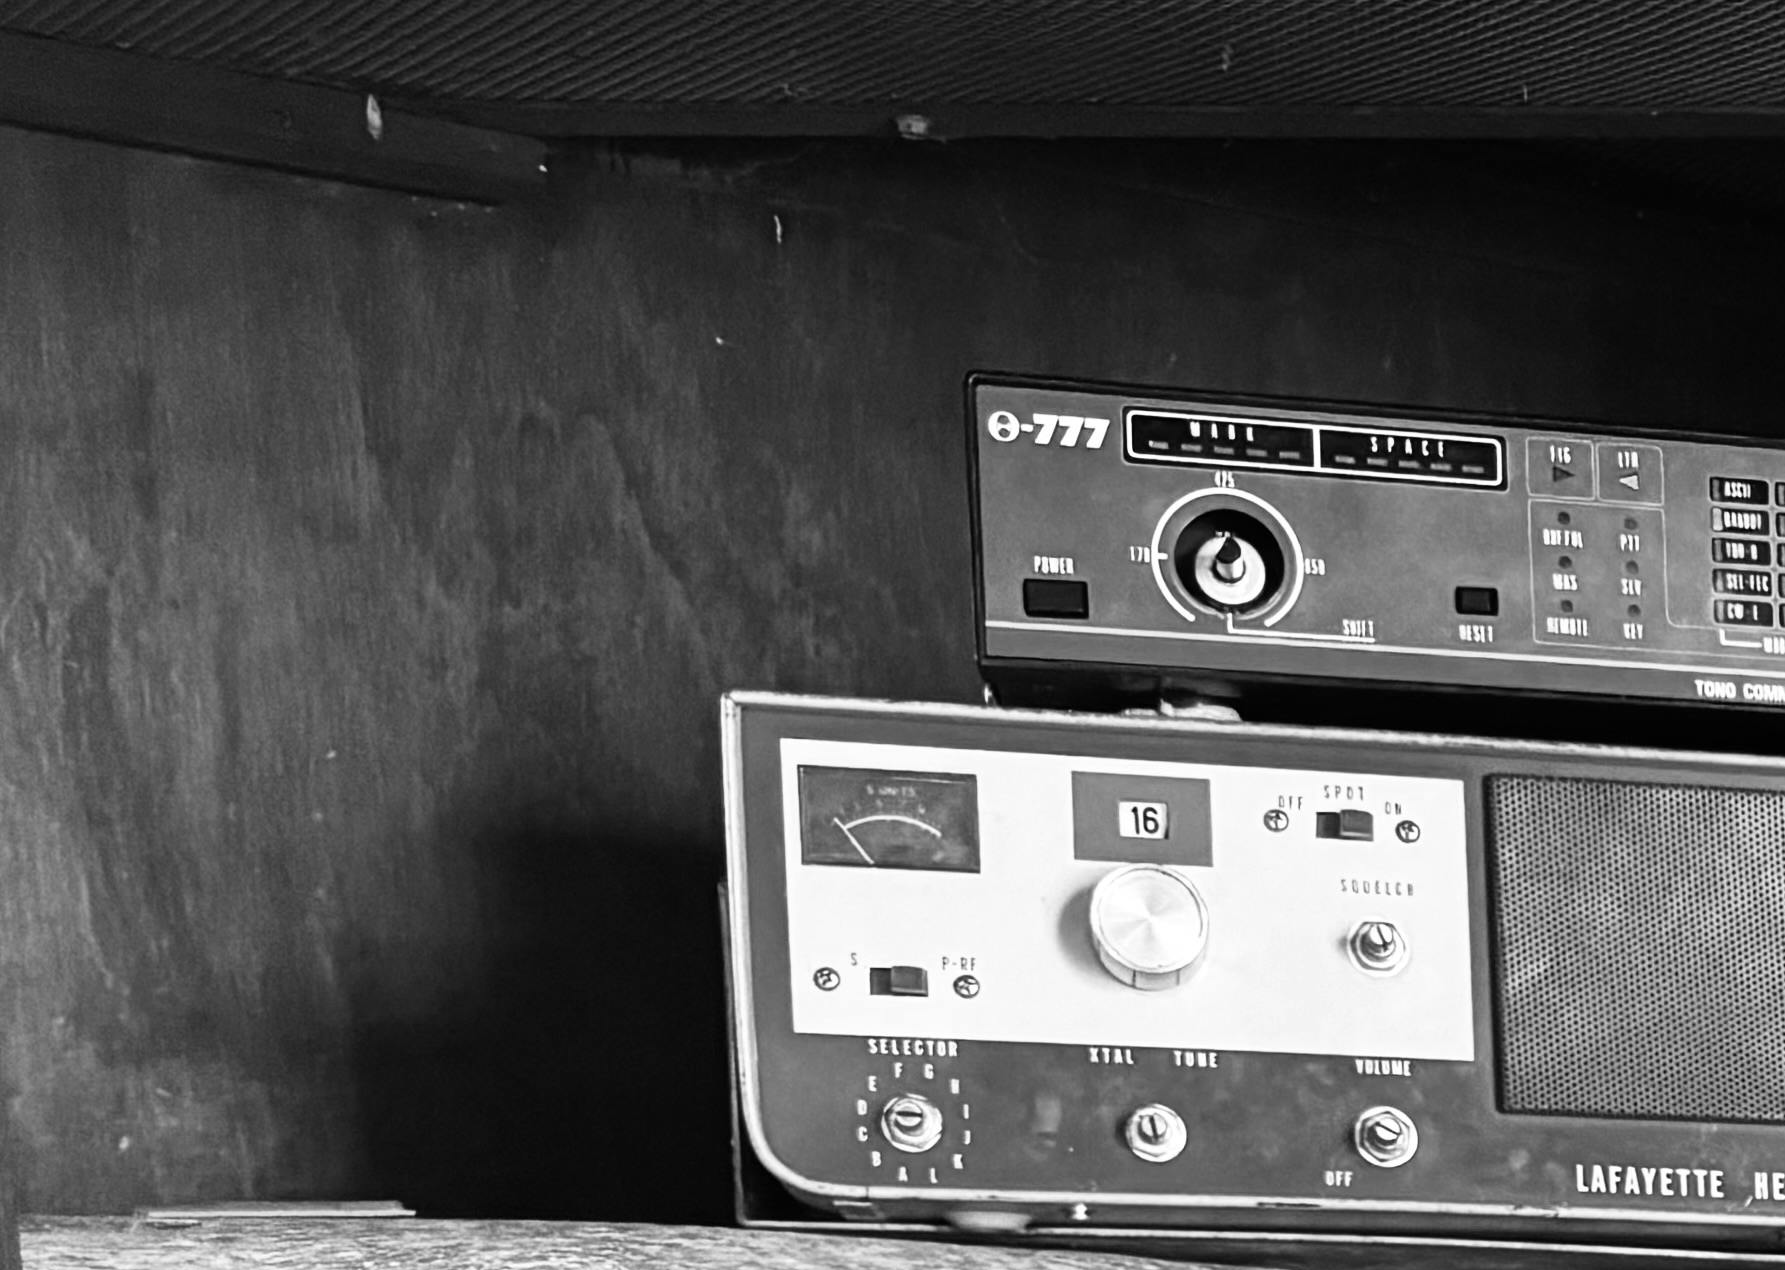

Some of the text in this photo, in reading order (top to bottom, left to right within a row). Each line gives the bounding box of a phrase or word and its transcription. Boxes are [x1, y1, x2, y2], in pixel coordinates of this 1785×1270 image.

[1371, 437, 1443, 457] SPACE
[1695, 680, 1736, 699] TONO
[1132, 807, 1159, 834] 16
[868, 1039, 957, 1056] SELECTOR
[1090, 1048, 1217, 1067] XTAL TUNE
[1355, 1059, 1411, 1076] VOLUME
[1576, 1164, 1724, 1198] LAFAYETTE
